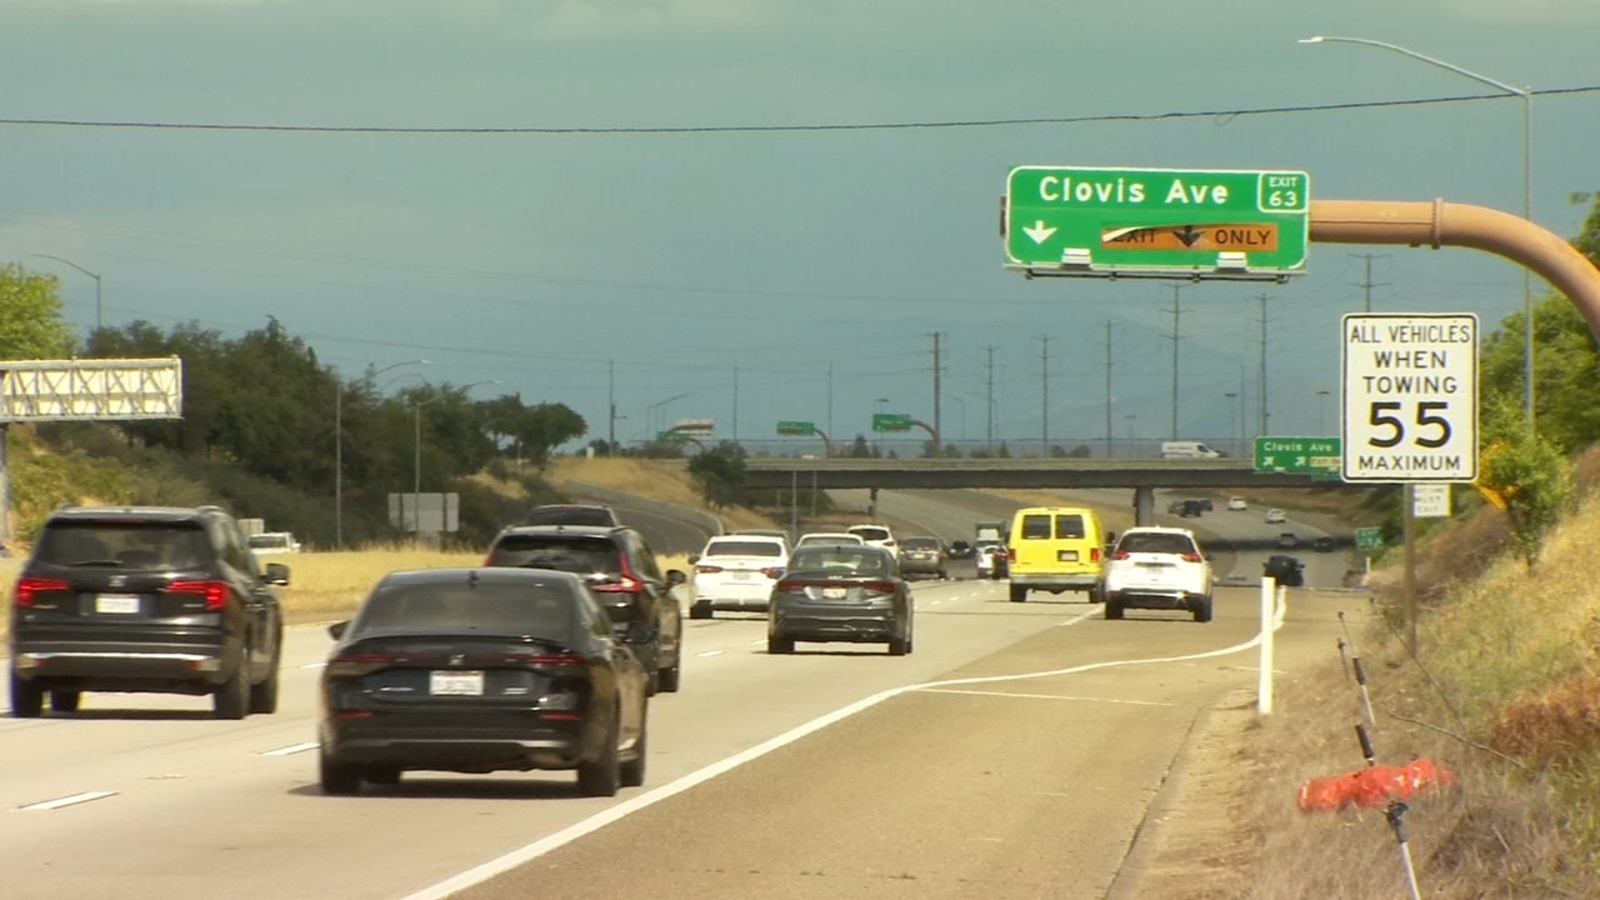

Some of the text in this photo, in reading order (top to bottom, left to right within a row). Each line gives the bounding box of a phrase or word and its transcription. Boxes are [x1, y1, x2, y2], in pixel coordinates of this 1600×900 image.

[1038, 176, 1229, 205] Clovis Ave
[1268, 176, 1298, 188] EXIT
[1268, 190, 1298, 208] 63
[1214, 228, 1272, 246] ONLY
[1350, 325, 1471, 343] ALL VEHICLES
[1374, 351, 1447, 369] WHEN
[1362, 376, 1458, 394] TOWING
[1368, 401, 1452, 448] 55
[1263, 442, 1333, 452] Clovis Ave
[1358, 455, 1461, 471] MAXIMUM
